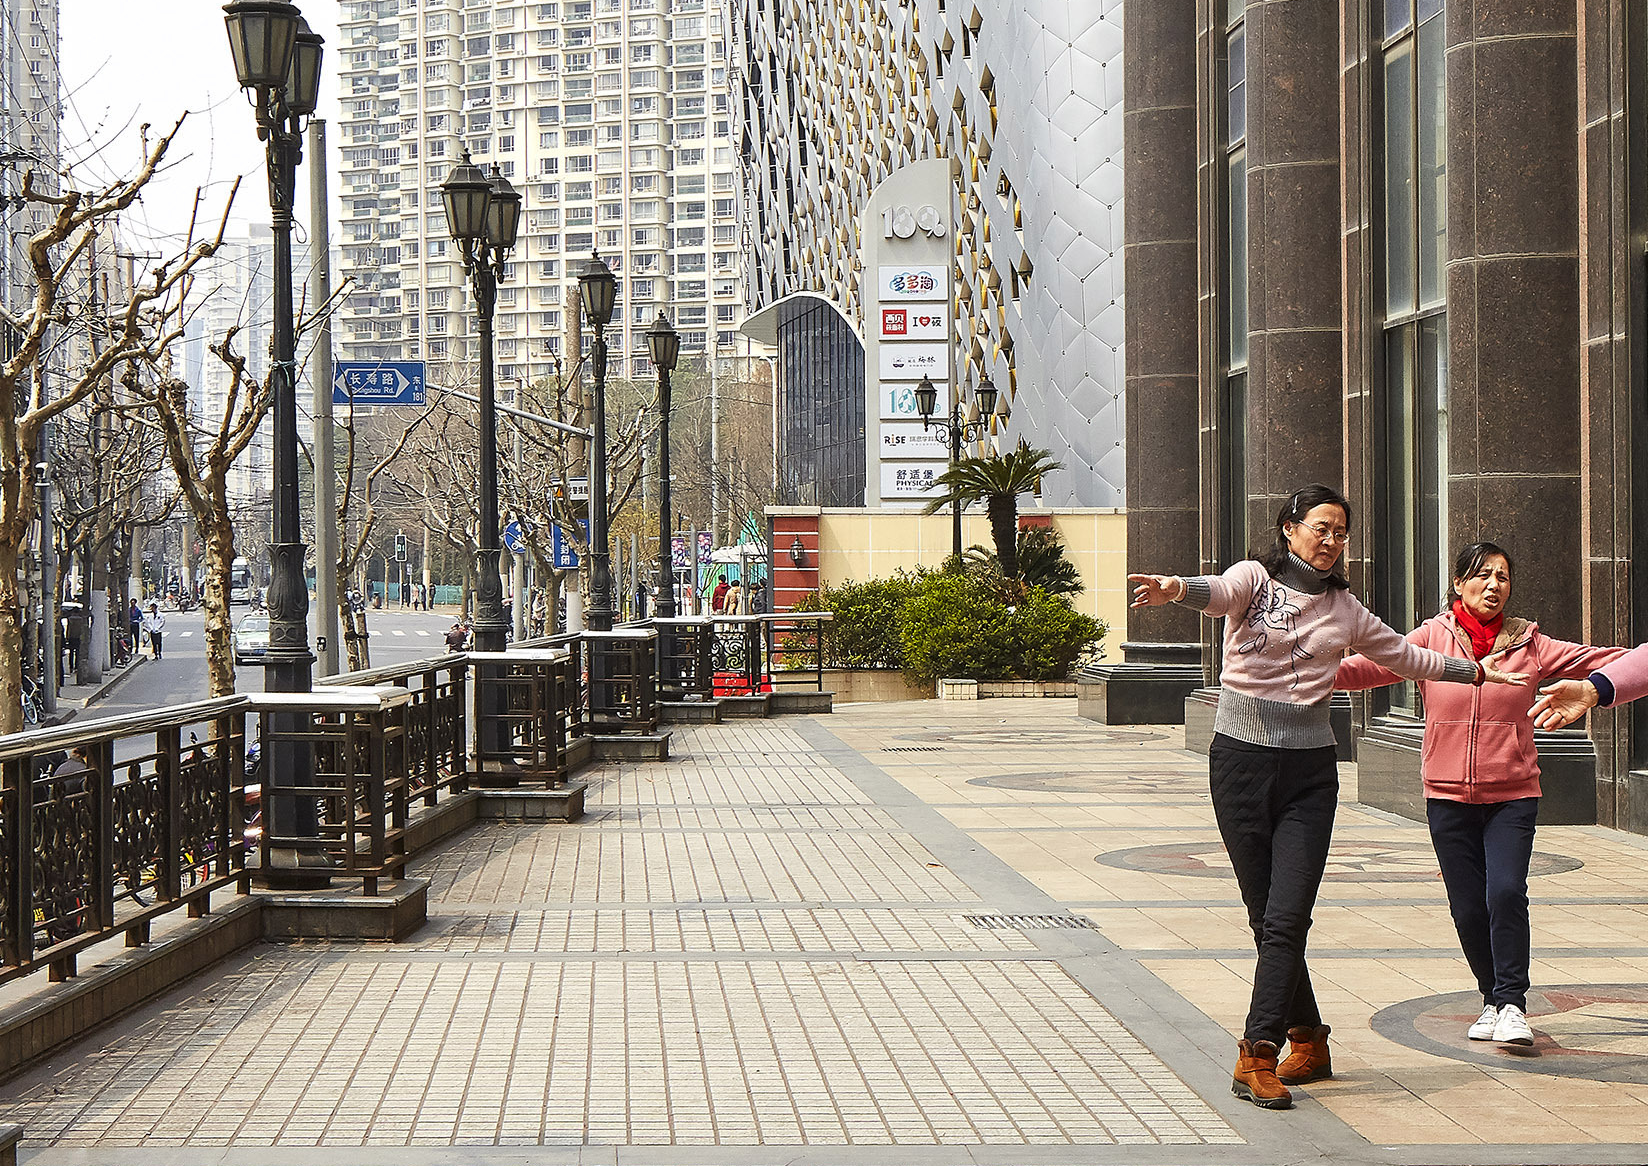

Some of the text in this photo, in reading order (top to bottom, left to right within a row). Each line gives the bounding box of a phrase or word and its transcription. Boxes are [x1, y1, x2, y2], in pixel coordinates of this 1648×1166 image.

[893, 275, 934, 291] 多多淘
[350, 372, 394, 385] 长寿路
[896, 469, 934, 480] 舒适堡
